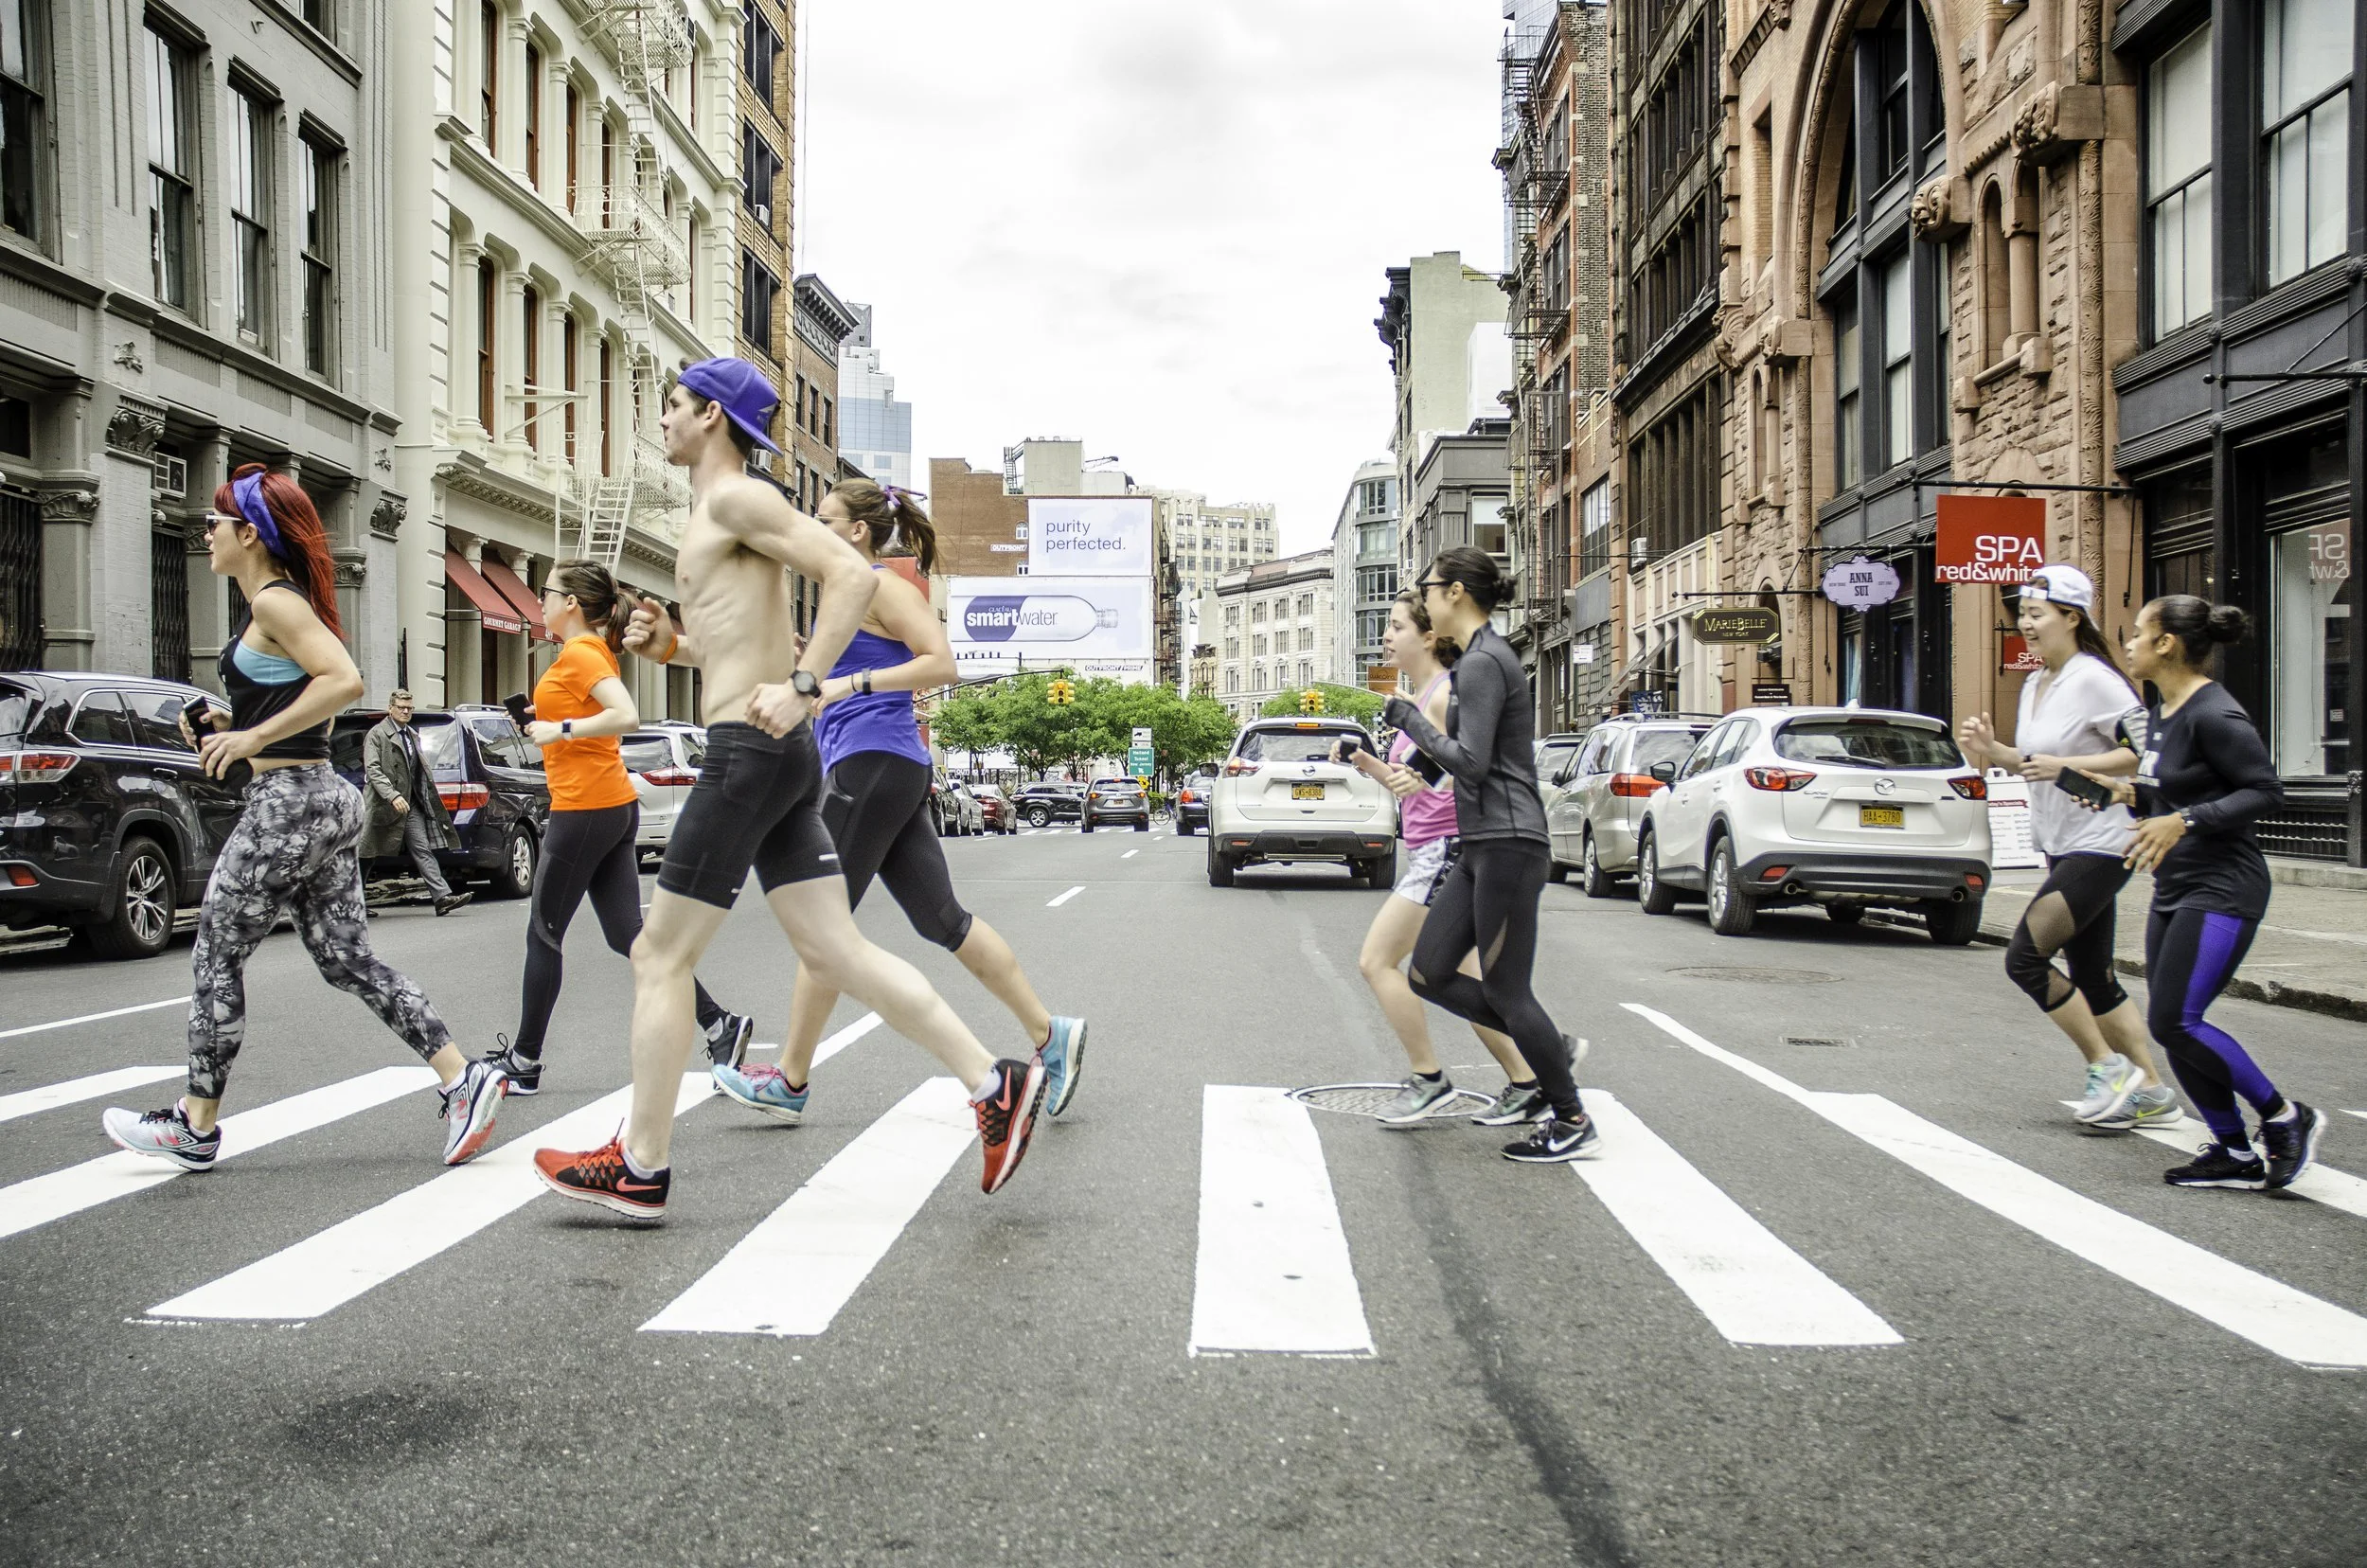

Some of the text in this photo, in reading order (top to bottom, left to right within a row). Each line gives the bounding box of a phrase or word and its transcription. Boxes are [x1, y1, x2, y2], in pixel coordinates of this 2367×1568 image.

[1046, 520, 1091, 536] purity
[1046, 537, 1126, 553] perfected.
[1975, 535, 2043, 562] SPA
[1849, 572, 1874, 583] ANNA
[1855, 585, 1869, 597] SUI
[484, 616, 521, 632] GOURMET GARAGE
[2018, 651, 2043, 663] SPA
